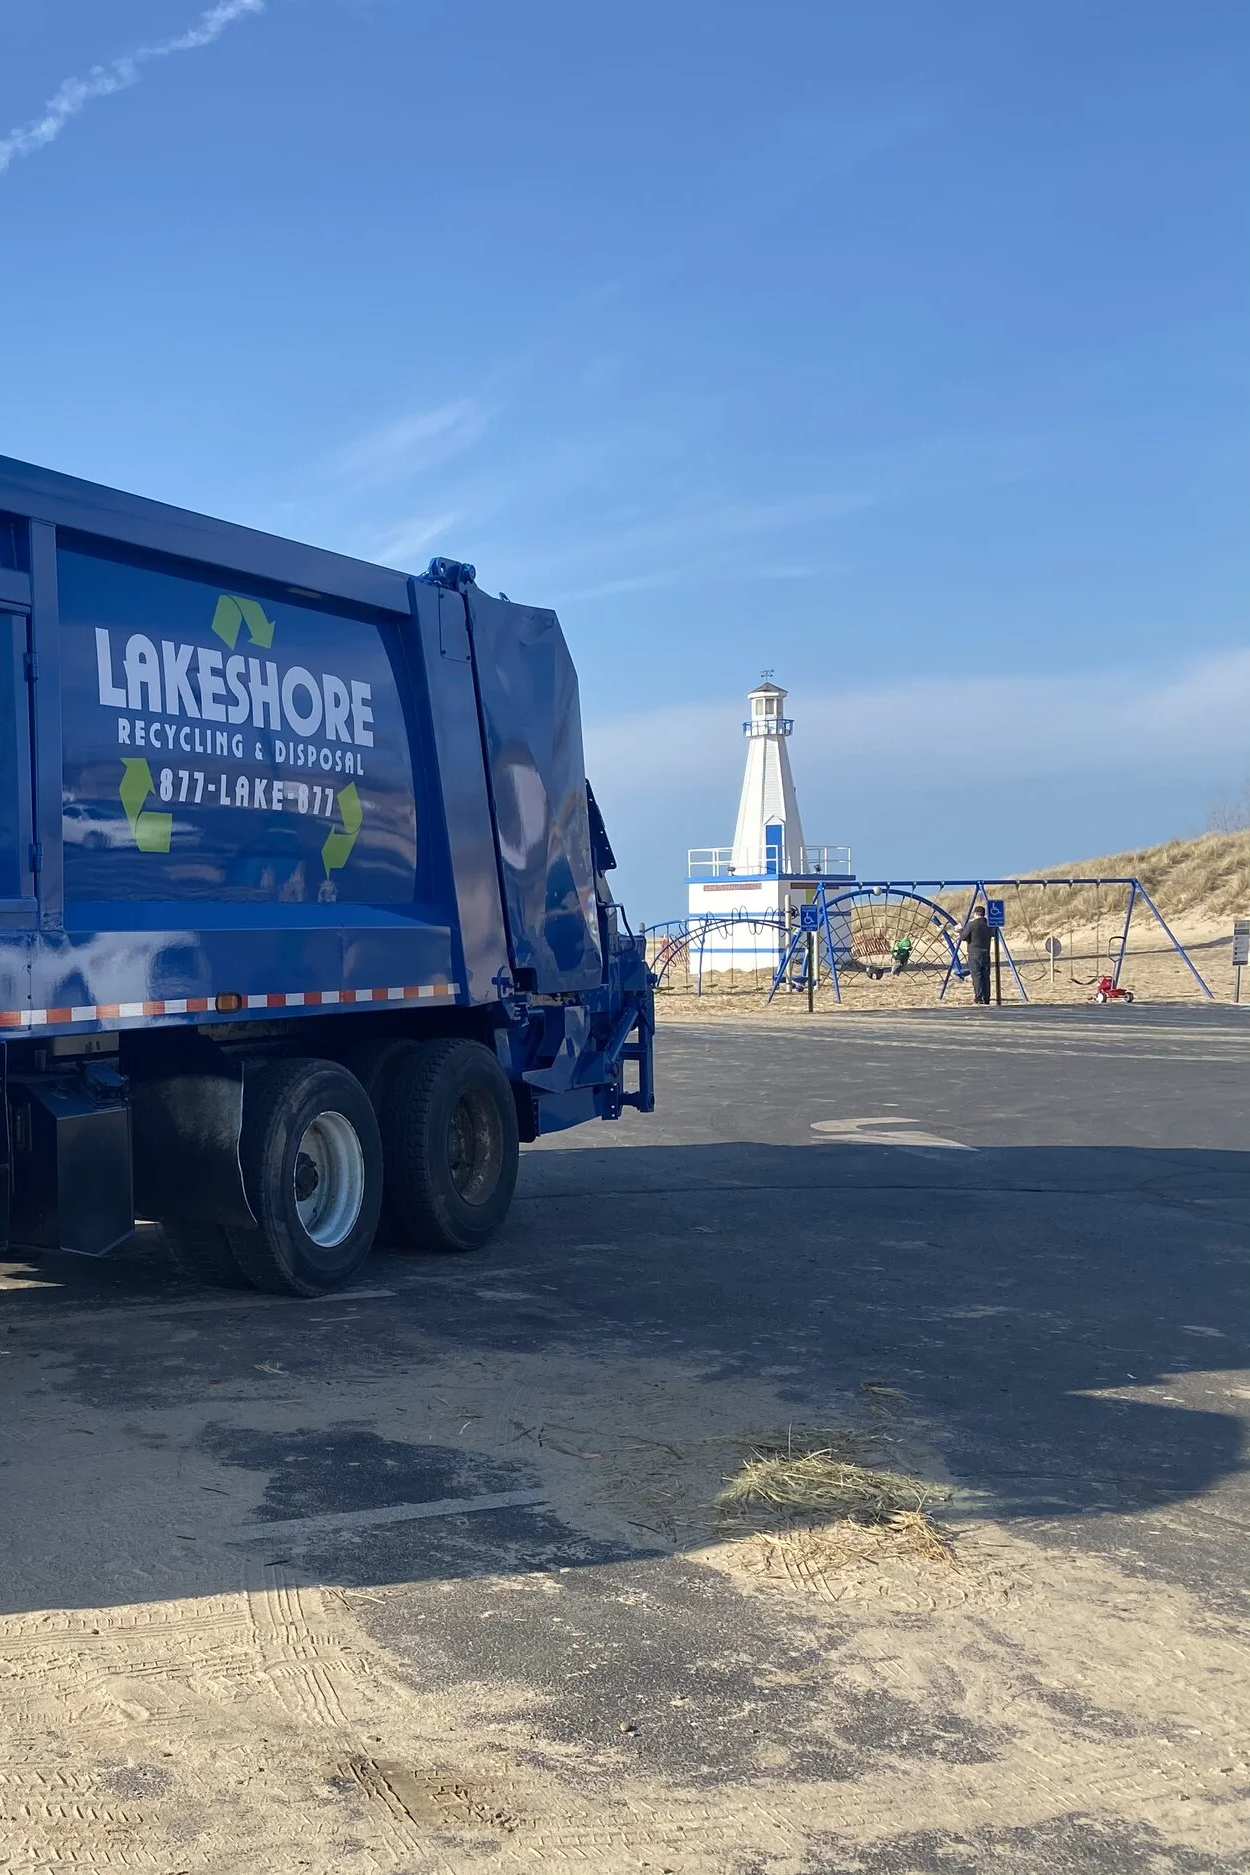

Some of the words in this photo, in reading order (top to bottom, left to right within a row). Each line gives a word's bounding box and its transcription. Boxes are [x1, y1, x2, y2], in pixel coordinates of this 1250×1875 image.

[95, 627, 374, 747] LAKESHORE
[118, 717, 243, 758] RECYCLING
[254, 742, 263, 760] &
[275, 740, 364, 775] DISPOSAL
[160, 767, 334, 816] 877-LAKE-877
